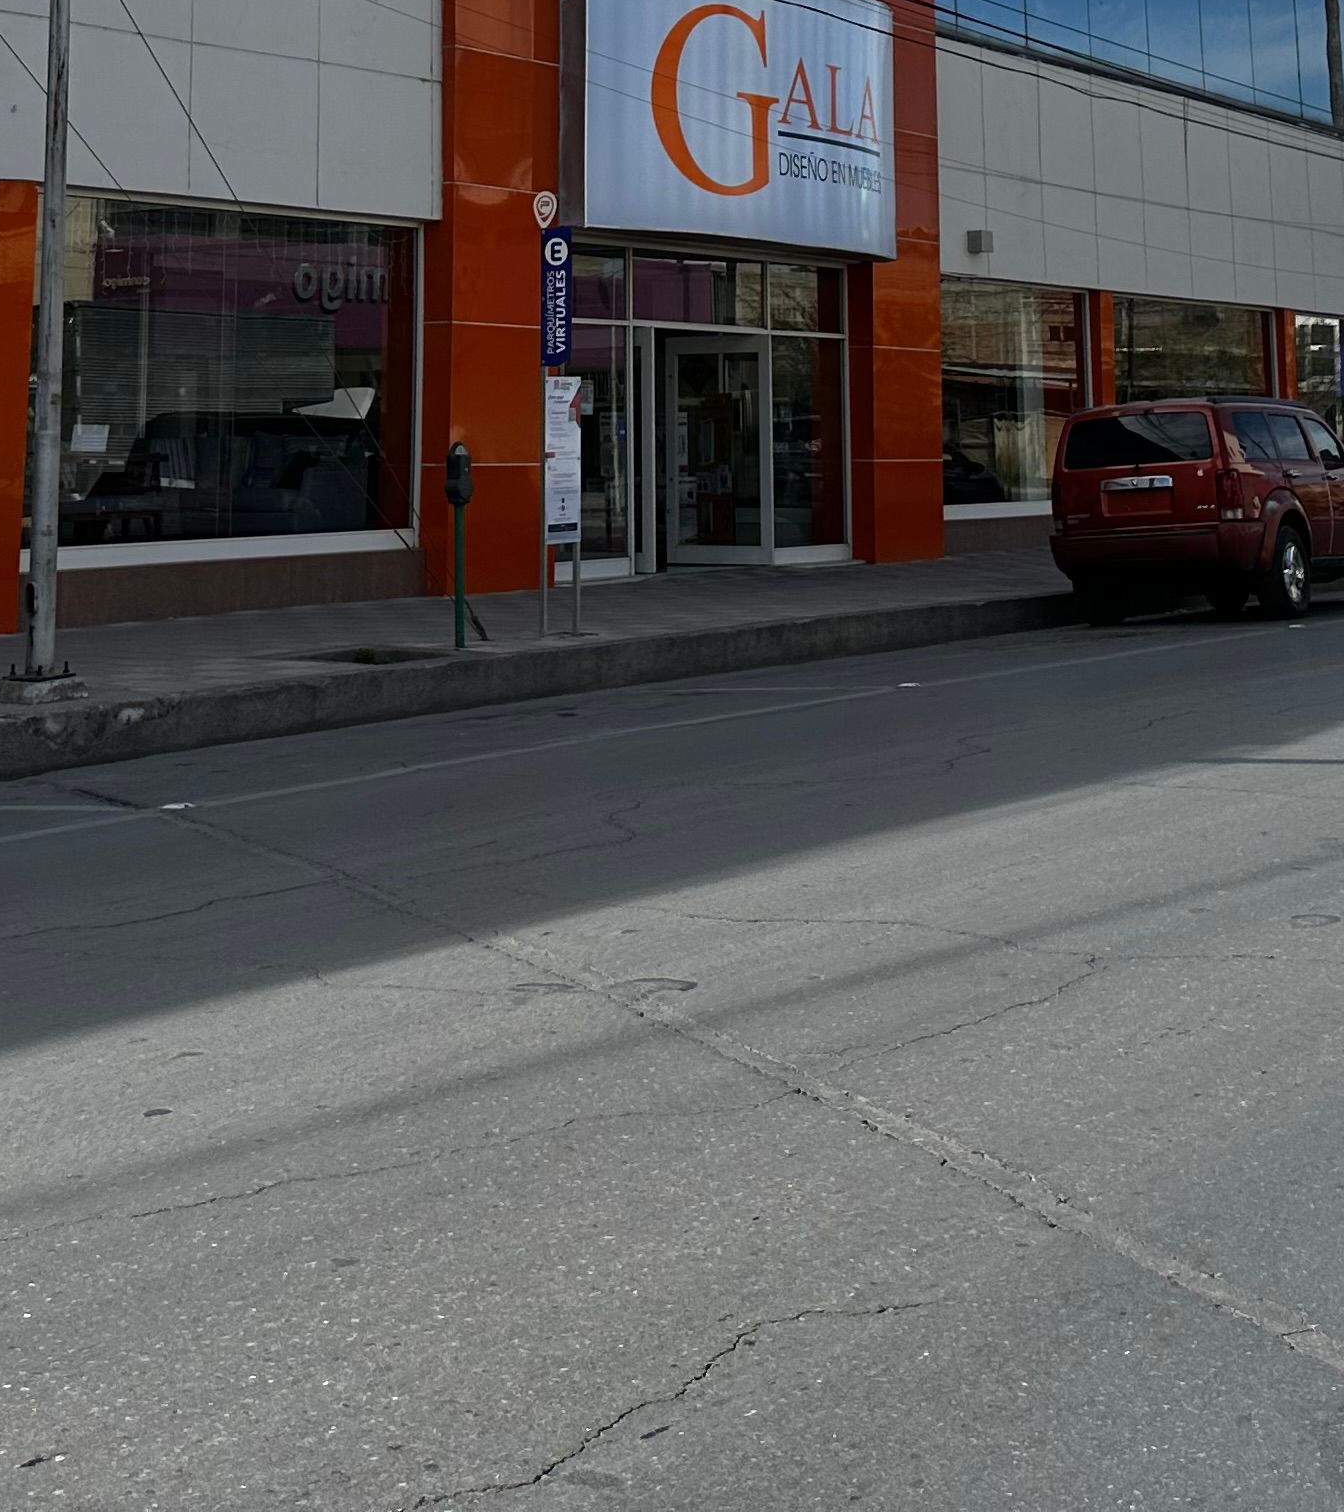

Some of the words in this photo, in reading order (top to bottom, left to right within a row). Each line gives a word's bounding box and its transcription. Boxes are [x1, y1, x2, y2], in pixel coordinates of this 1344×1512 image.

[778, 151, 829, 183] DISEÑO
[831, 160, 846, 186] EN
[847, 164, 883, 195] MUEBLES
[546, 270, 556, 356] PARQUÍMETROS
[555, 269, 567, 355] VIRTUALES
